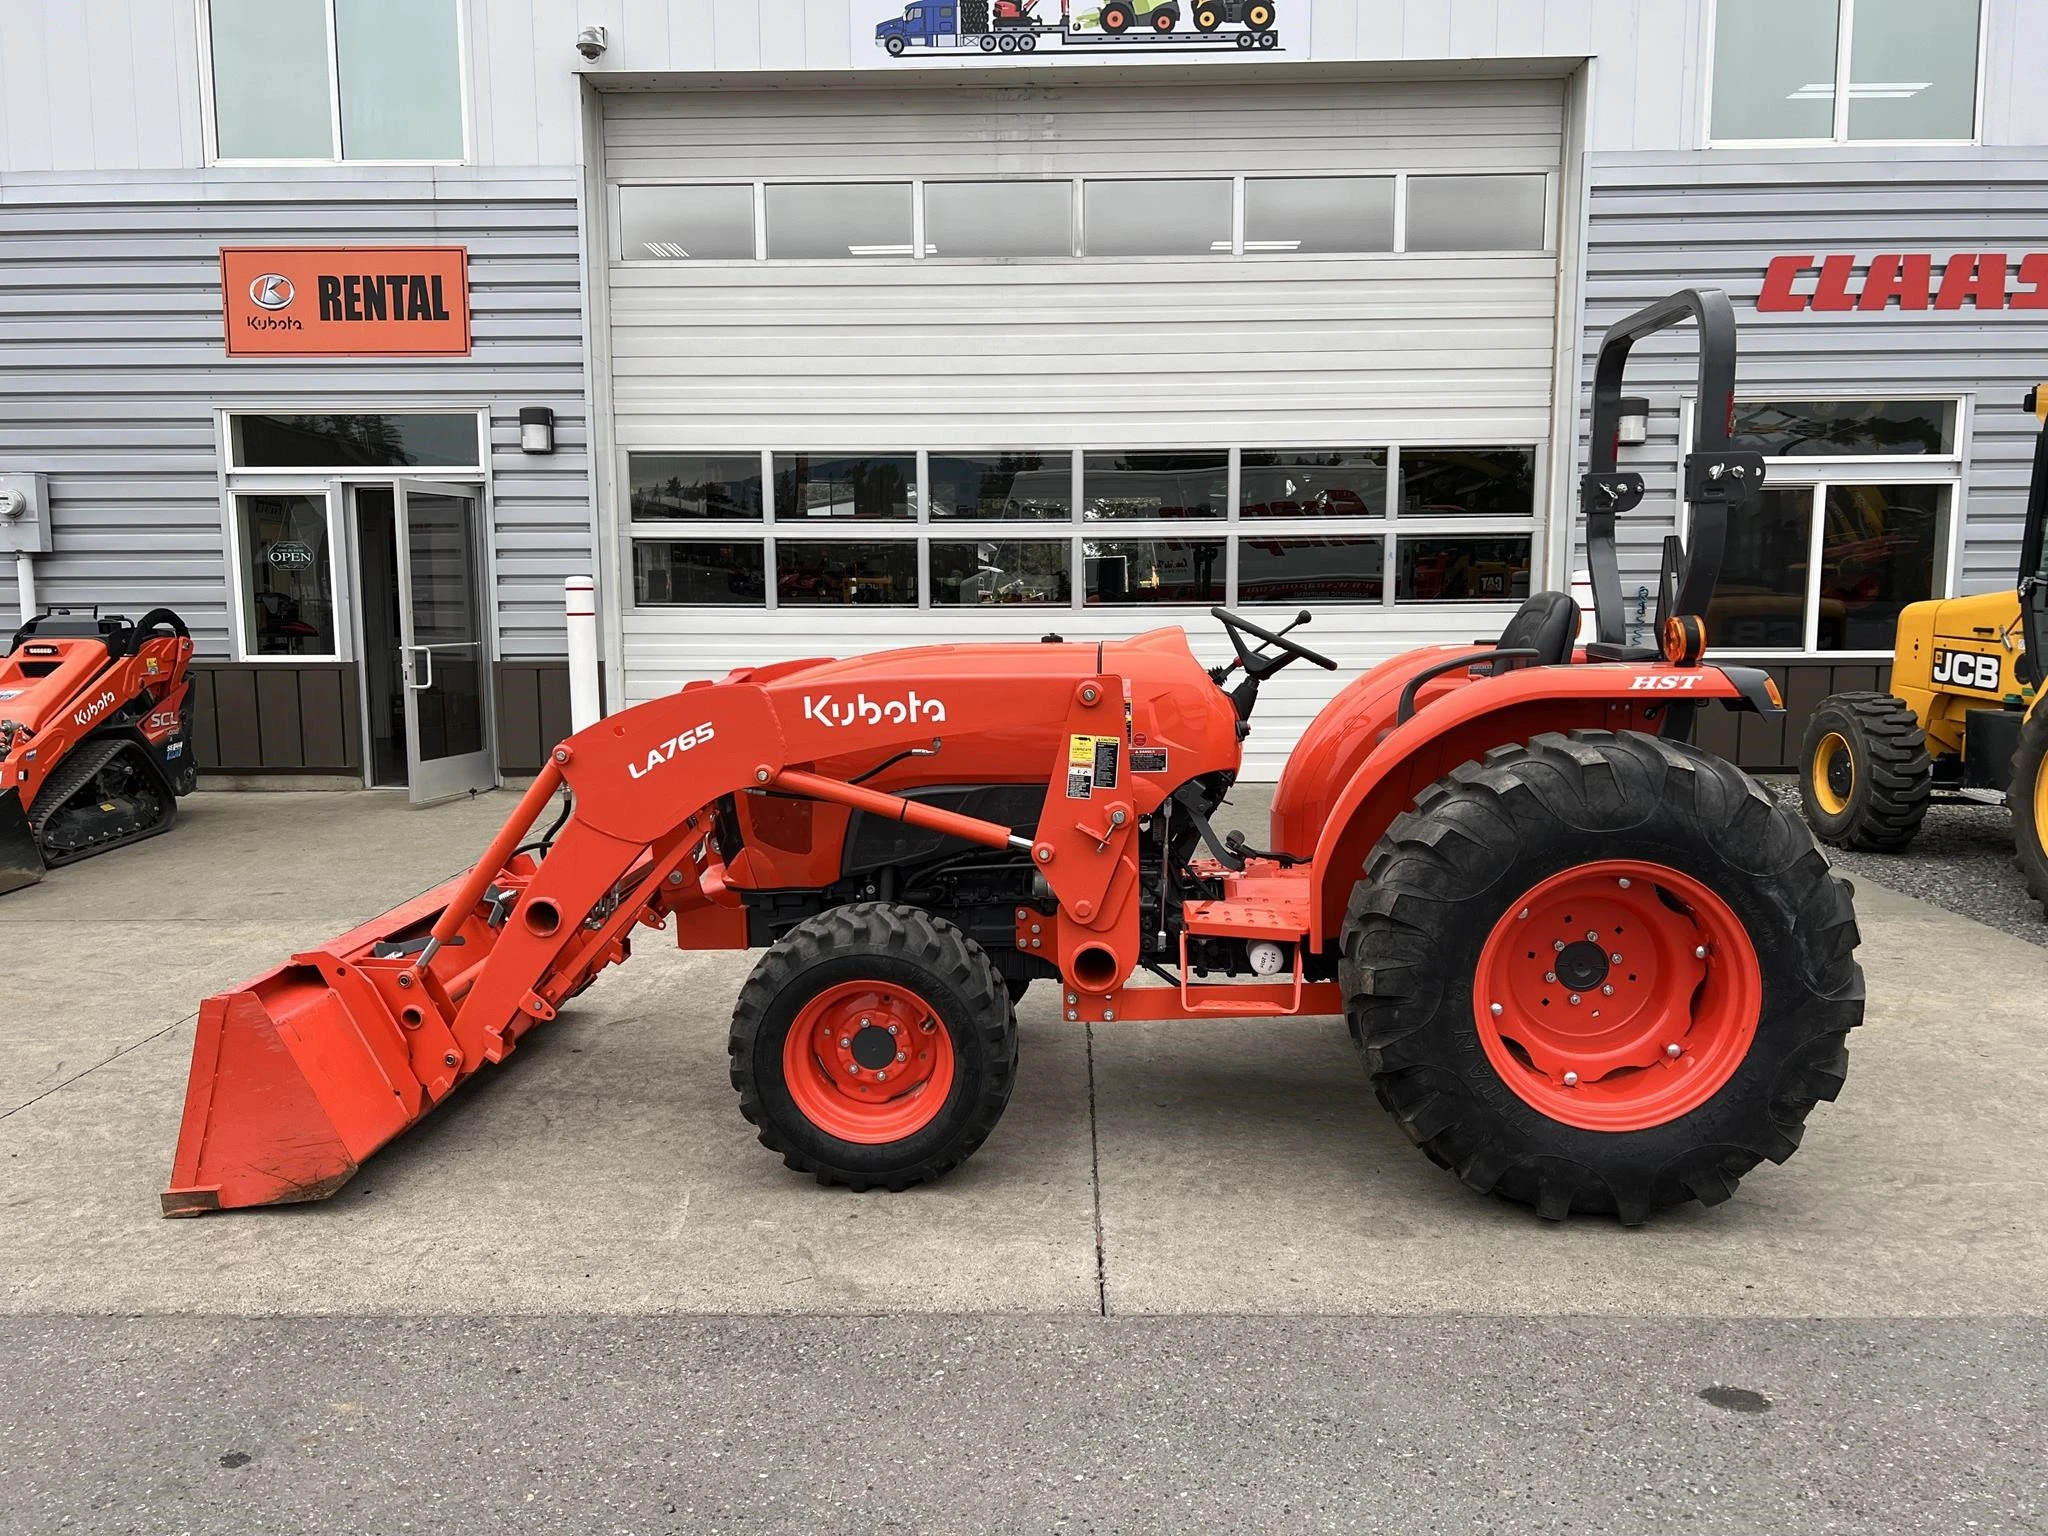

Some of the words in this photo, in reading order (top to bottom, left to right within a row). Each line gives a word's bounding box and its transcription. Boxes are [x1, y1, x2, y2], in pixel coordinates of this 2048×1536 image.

[317, 275, 450, 321] RENTAL
[1756, 253, 2048, 312] CLAAS
[247, 316, 302, 330] Kubota
[270, 552, 312, 562] OPEN
[1629, 675, 1704, 690] HST
[1933, 652, 1999, 689] JCB
[73, 691, 116, 726] Kubota
[150, 712, 179, 728] SCL
[803, 691, 946, 727] Kubota
[628, 721, 715, 779] LA765
